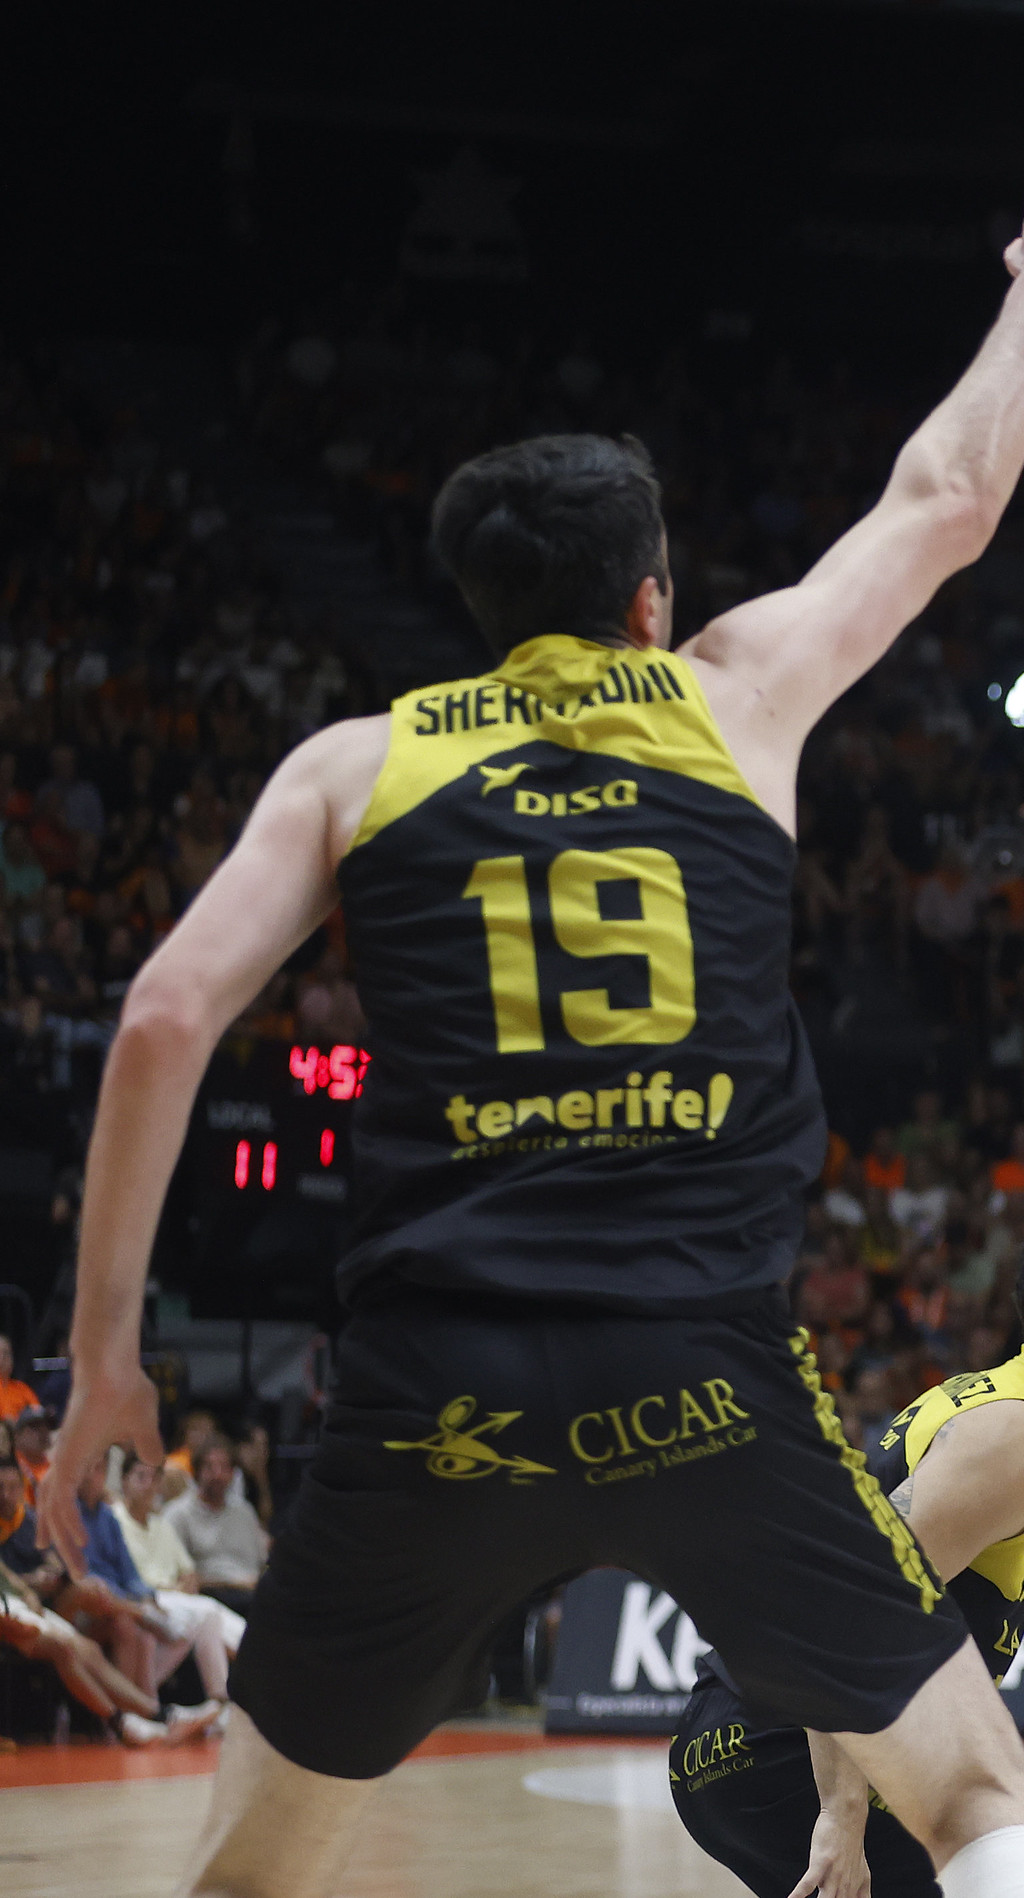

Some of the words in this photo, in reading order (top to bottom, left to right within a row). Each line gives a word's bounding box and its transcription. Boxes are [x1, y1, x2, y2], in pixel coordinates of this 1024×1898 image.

[461, 847, 698, 1053] 19
[235, 1139, 278, 1191] 11
[568, 1378, 751, 1464] CICAR
[683, 1723, 751, 1776] CICAR
